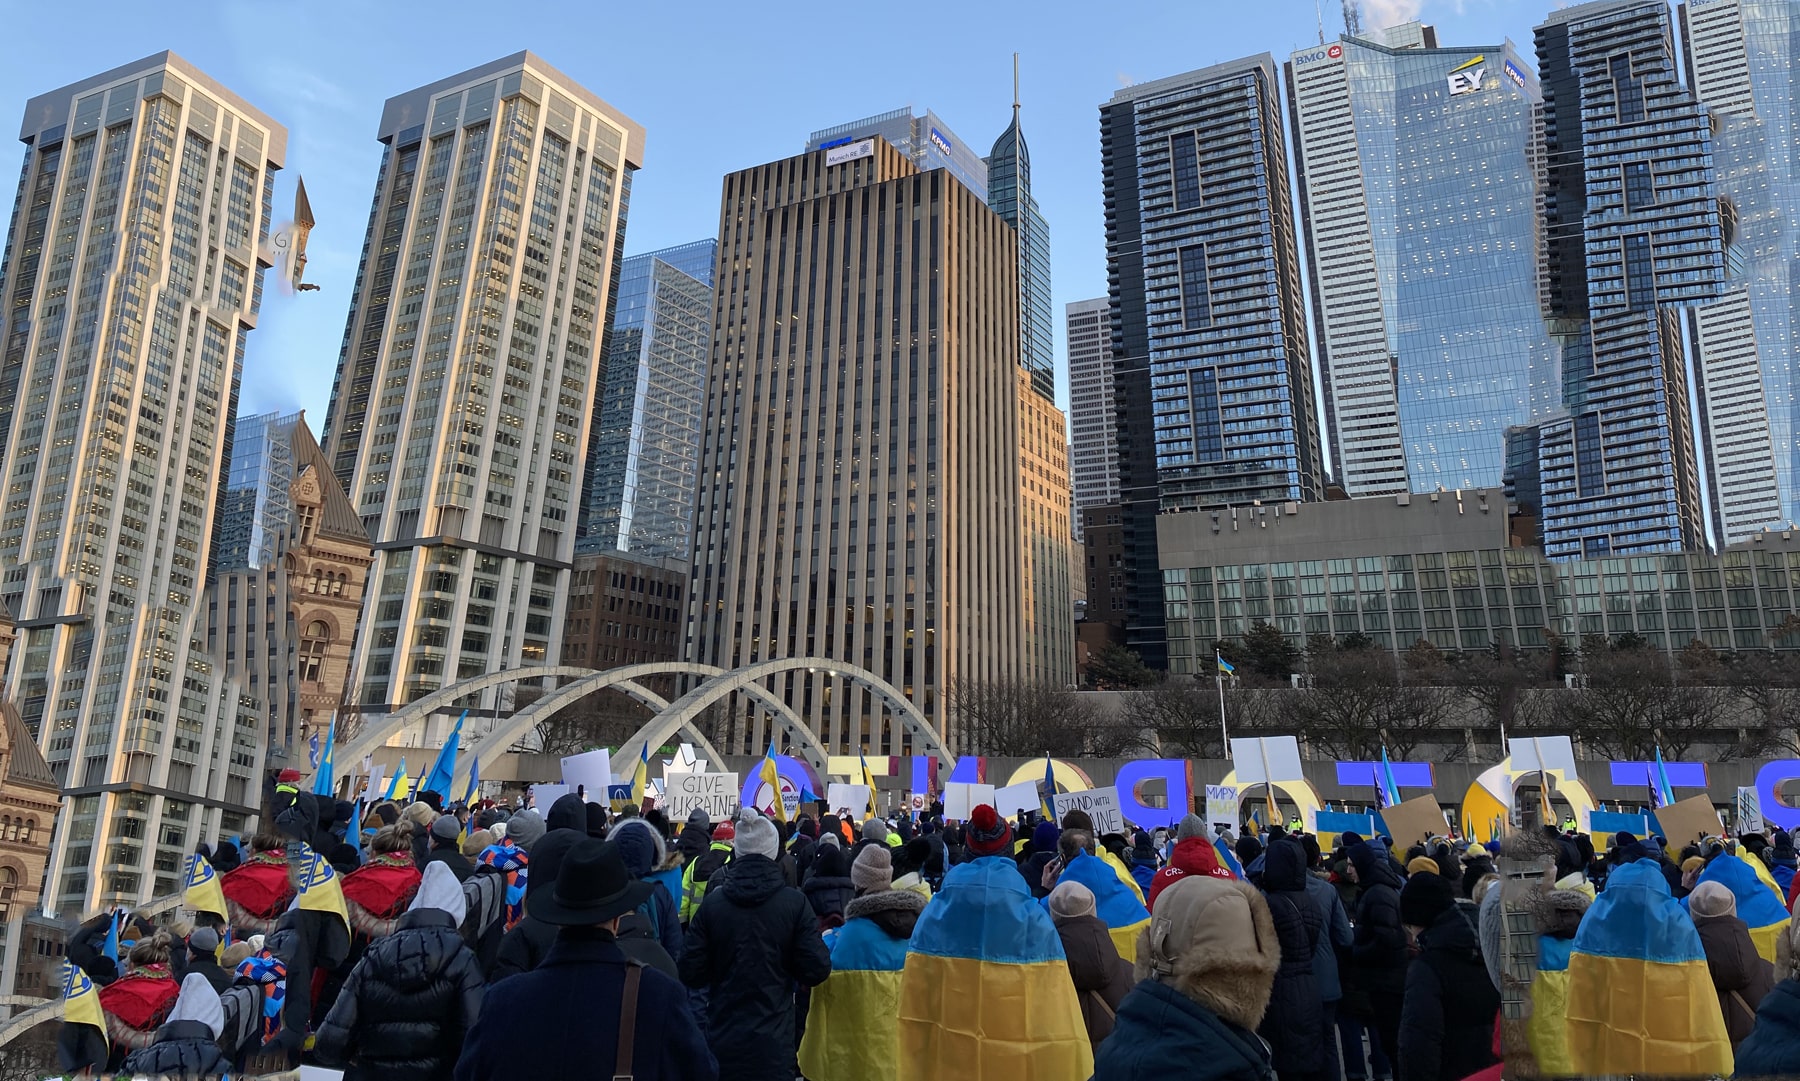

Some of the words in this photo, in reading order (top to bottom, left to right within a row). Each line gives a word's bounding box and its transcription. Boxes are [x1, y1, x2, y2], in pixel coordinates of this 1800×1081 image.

[1296, 51, 1326, 66] BMO
[1447, 68, 1486, 96] EY
[1504, 63, 1526, 88] KPMG
[931, 133, 951, 156] KPMG
[682, 775, 724, 793] GIVE
[1057, 795, 1093, 815] STAND
[1093, 796, 1110, 807] WITH
